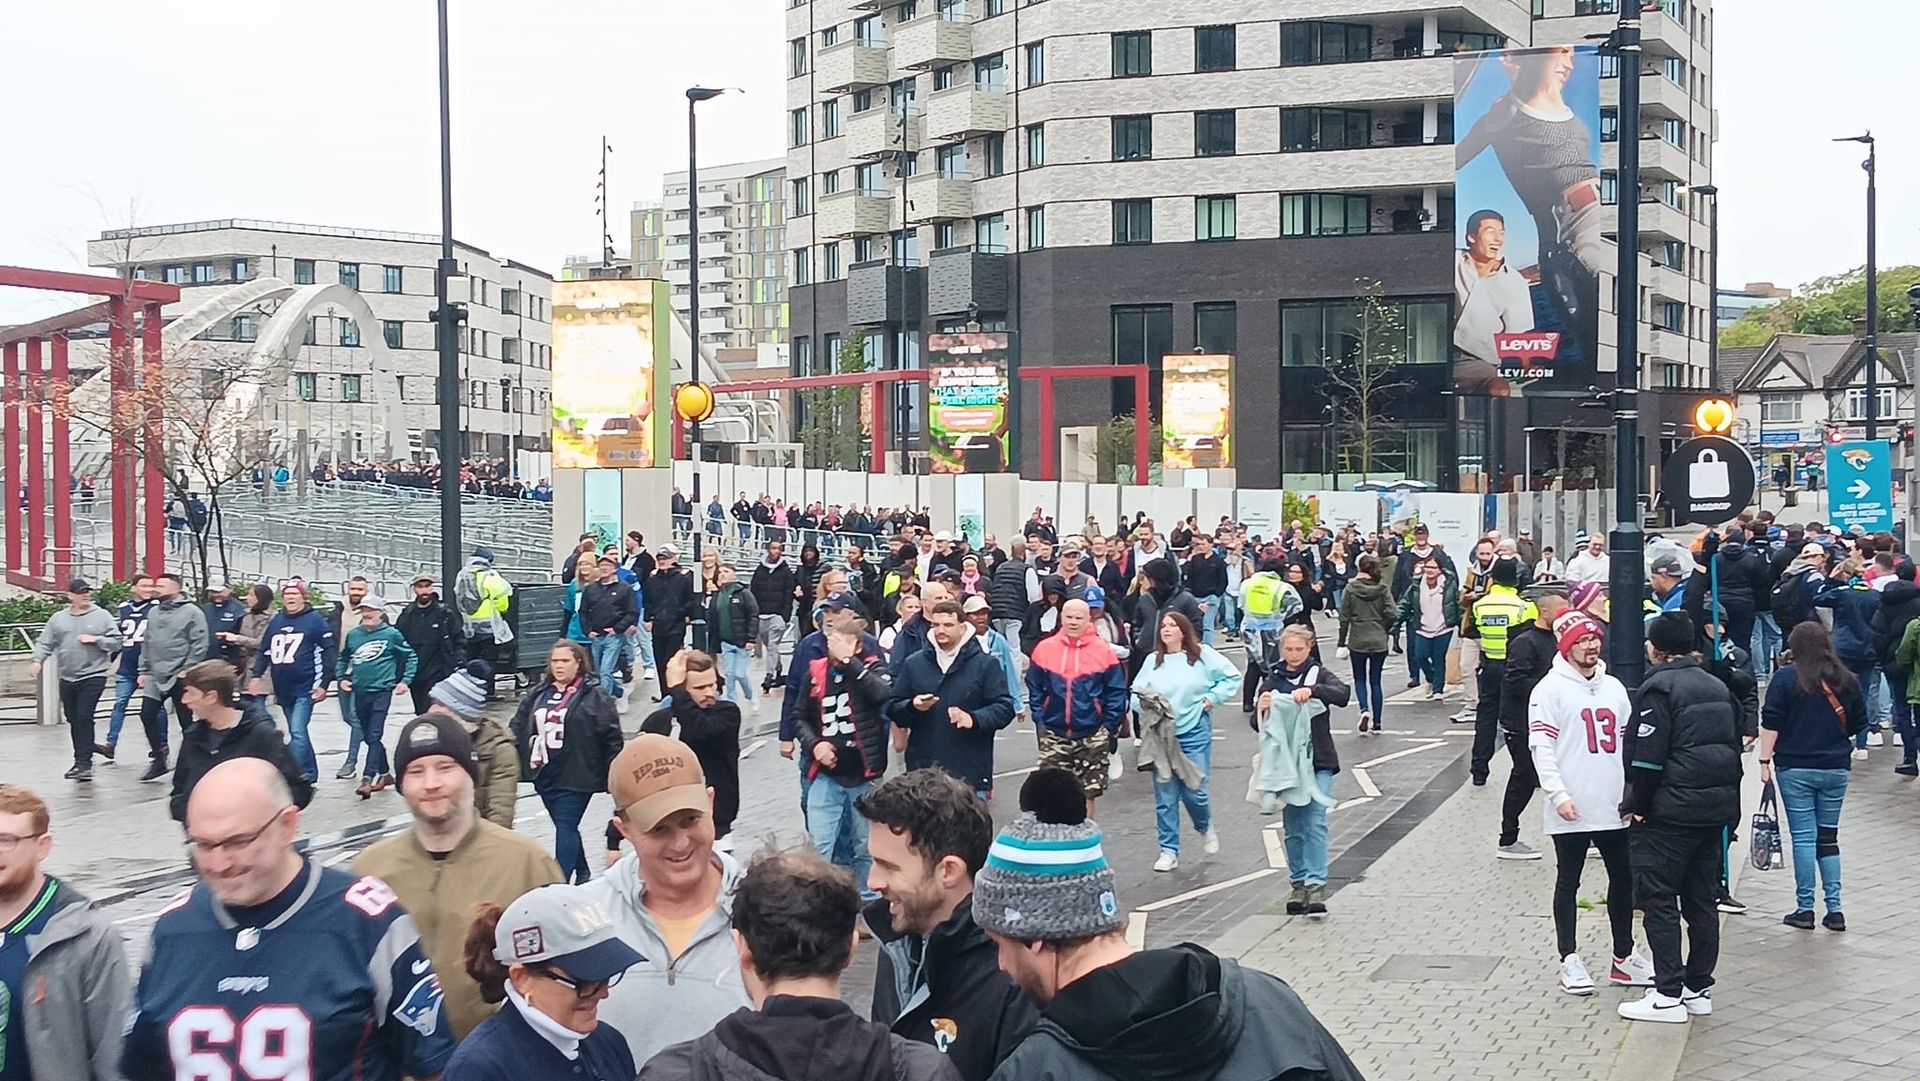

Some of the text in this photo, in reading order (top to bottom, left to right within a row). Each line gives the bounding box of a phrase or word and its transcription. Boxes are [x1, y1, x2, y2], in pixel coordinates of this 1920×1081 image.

[1496, 367, 1555, 378] LEVI.COM
[966, 395, 997, 405] RIGHT
[1480, 616, 1508, 626] POLICE
[270, 632, 305, 665] 87
[1580, 707, 1617, 754] 13
[632, 763, 654, 784] RED
[167, 1003, 314, 1081] 69
